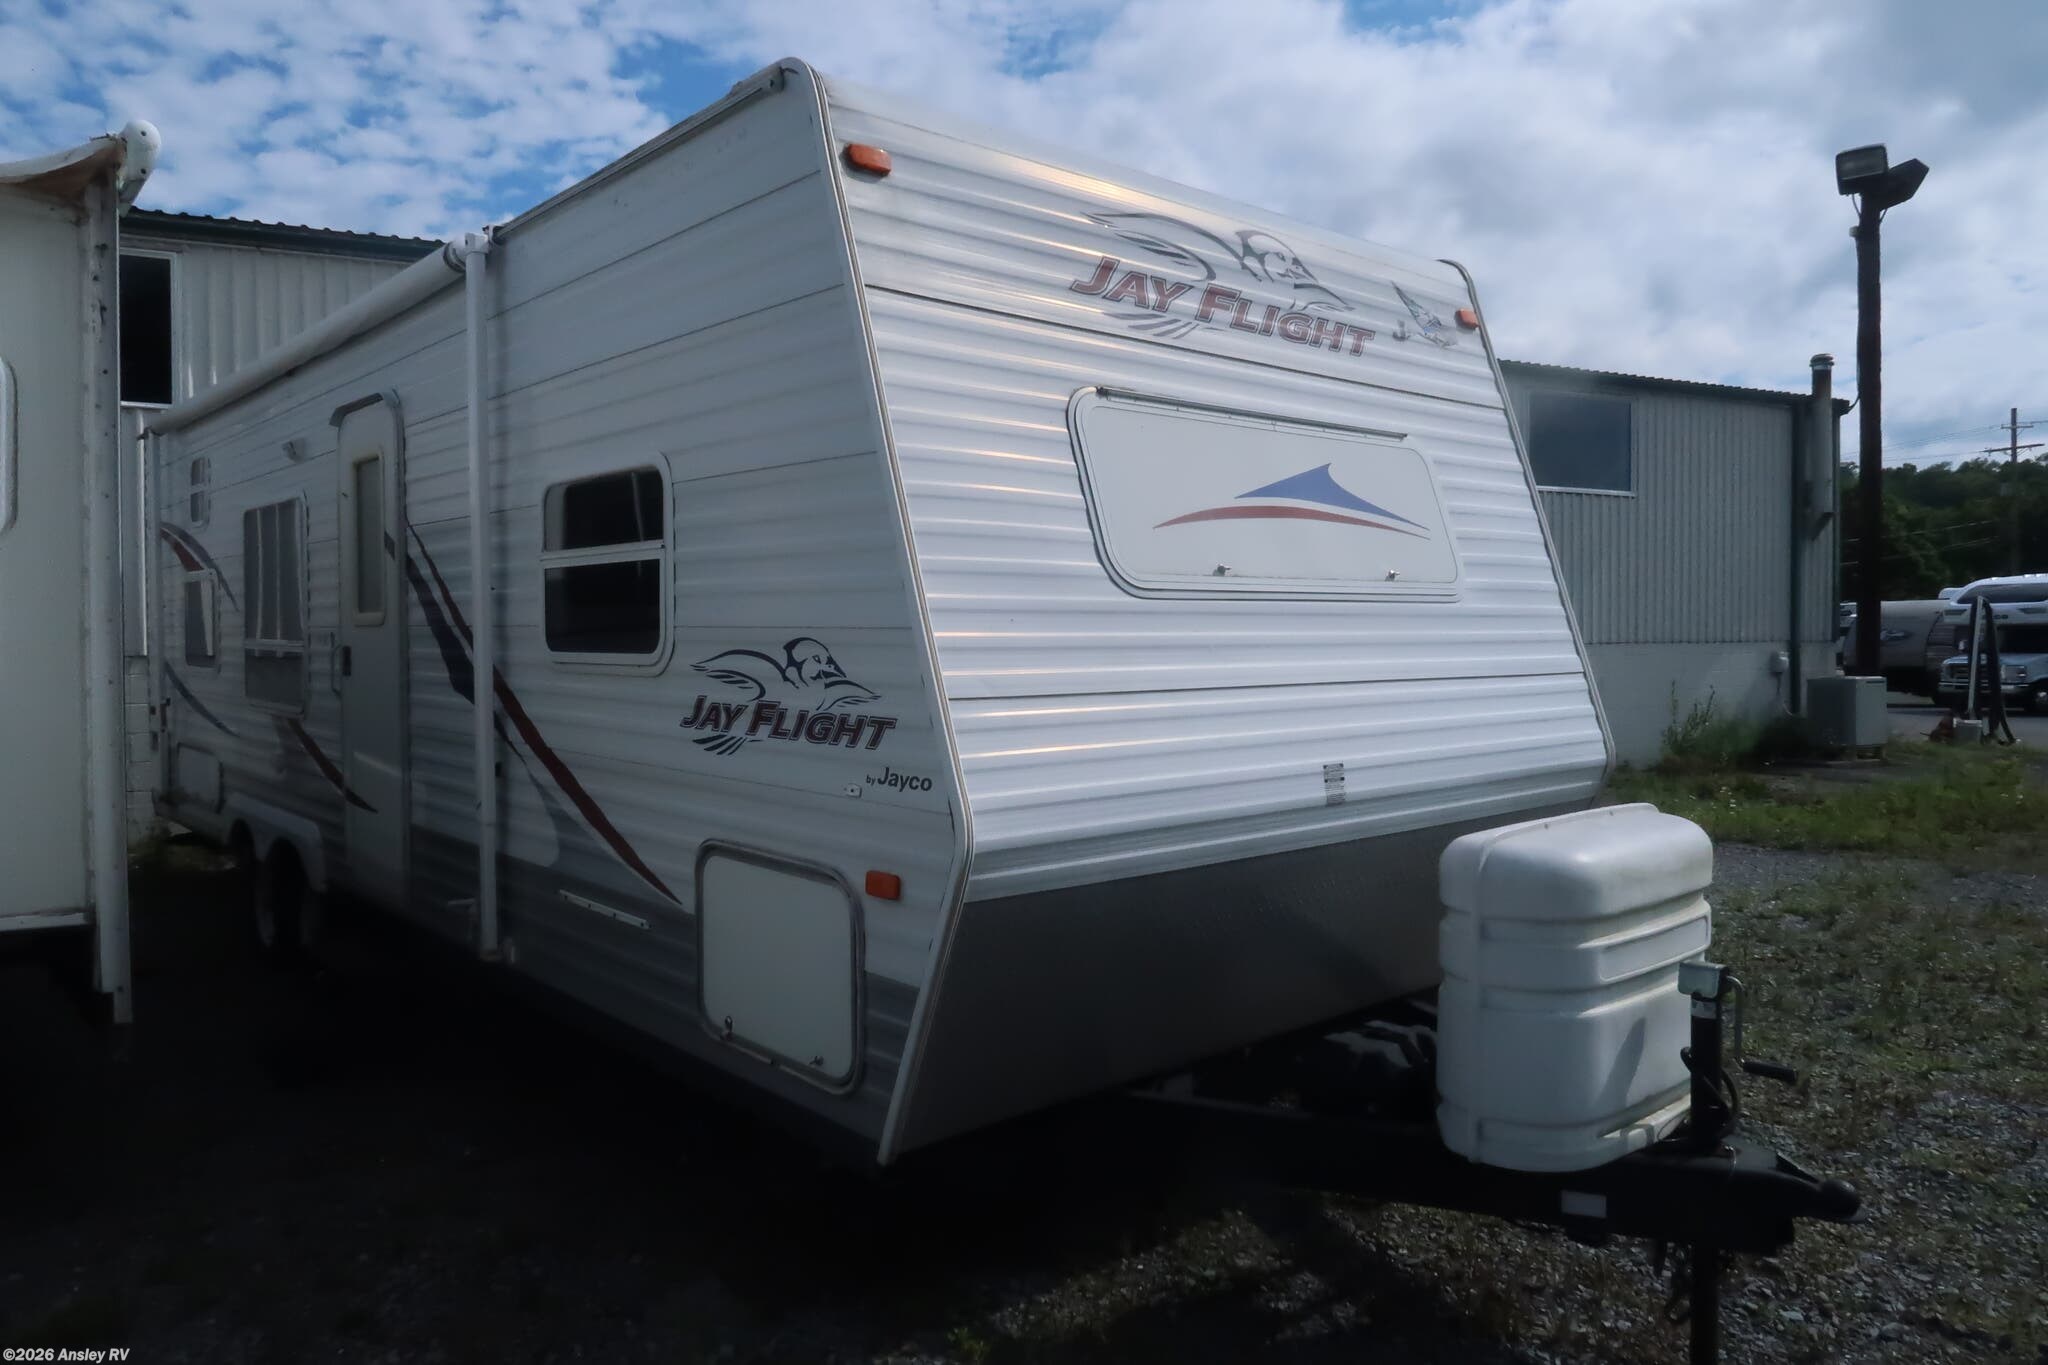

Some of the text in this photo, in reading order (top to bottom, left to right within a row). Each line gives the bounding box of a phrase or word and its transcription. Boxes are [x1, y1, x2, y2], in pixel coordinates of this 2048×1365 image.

[1069, 256, 1376, 357] JAY FLIGHT
[679, 695, 898, 750] JAY FLIGHT
[865, 767, 932, 792] by Jayco
